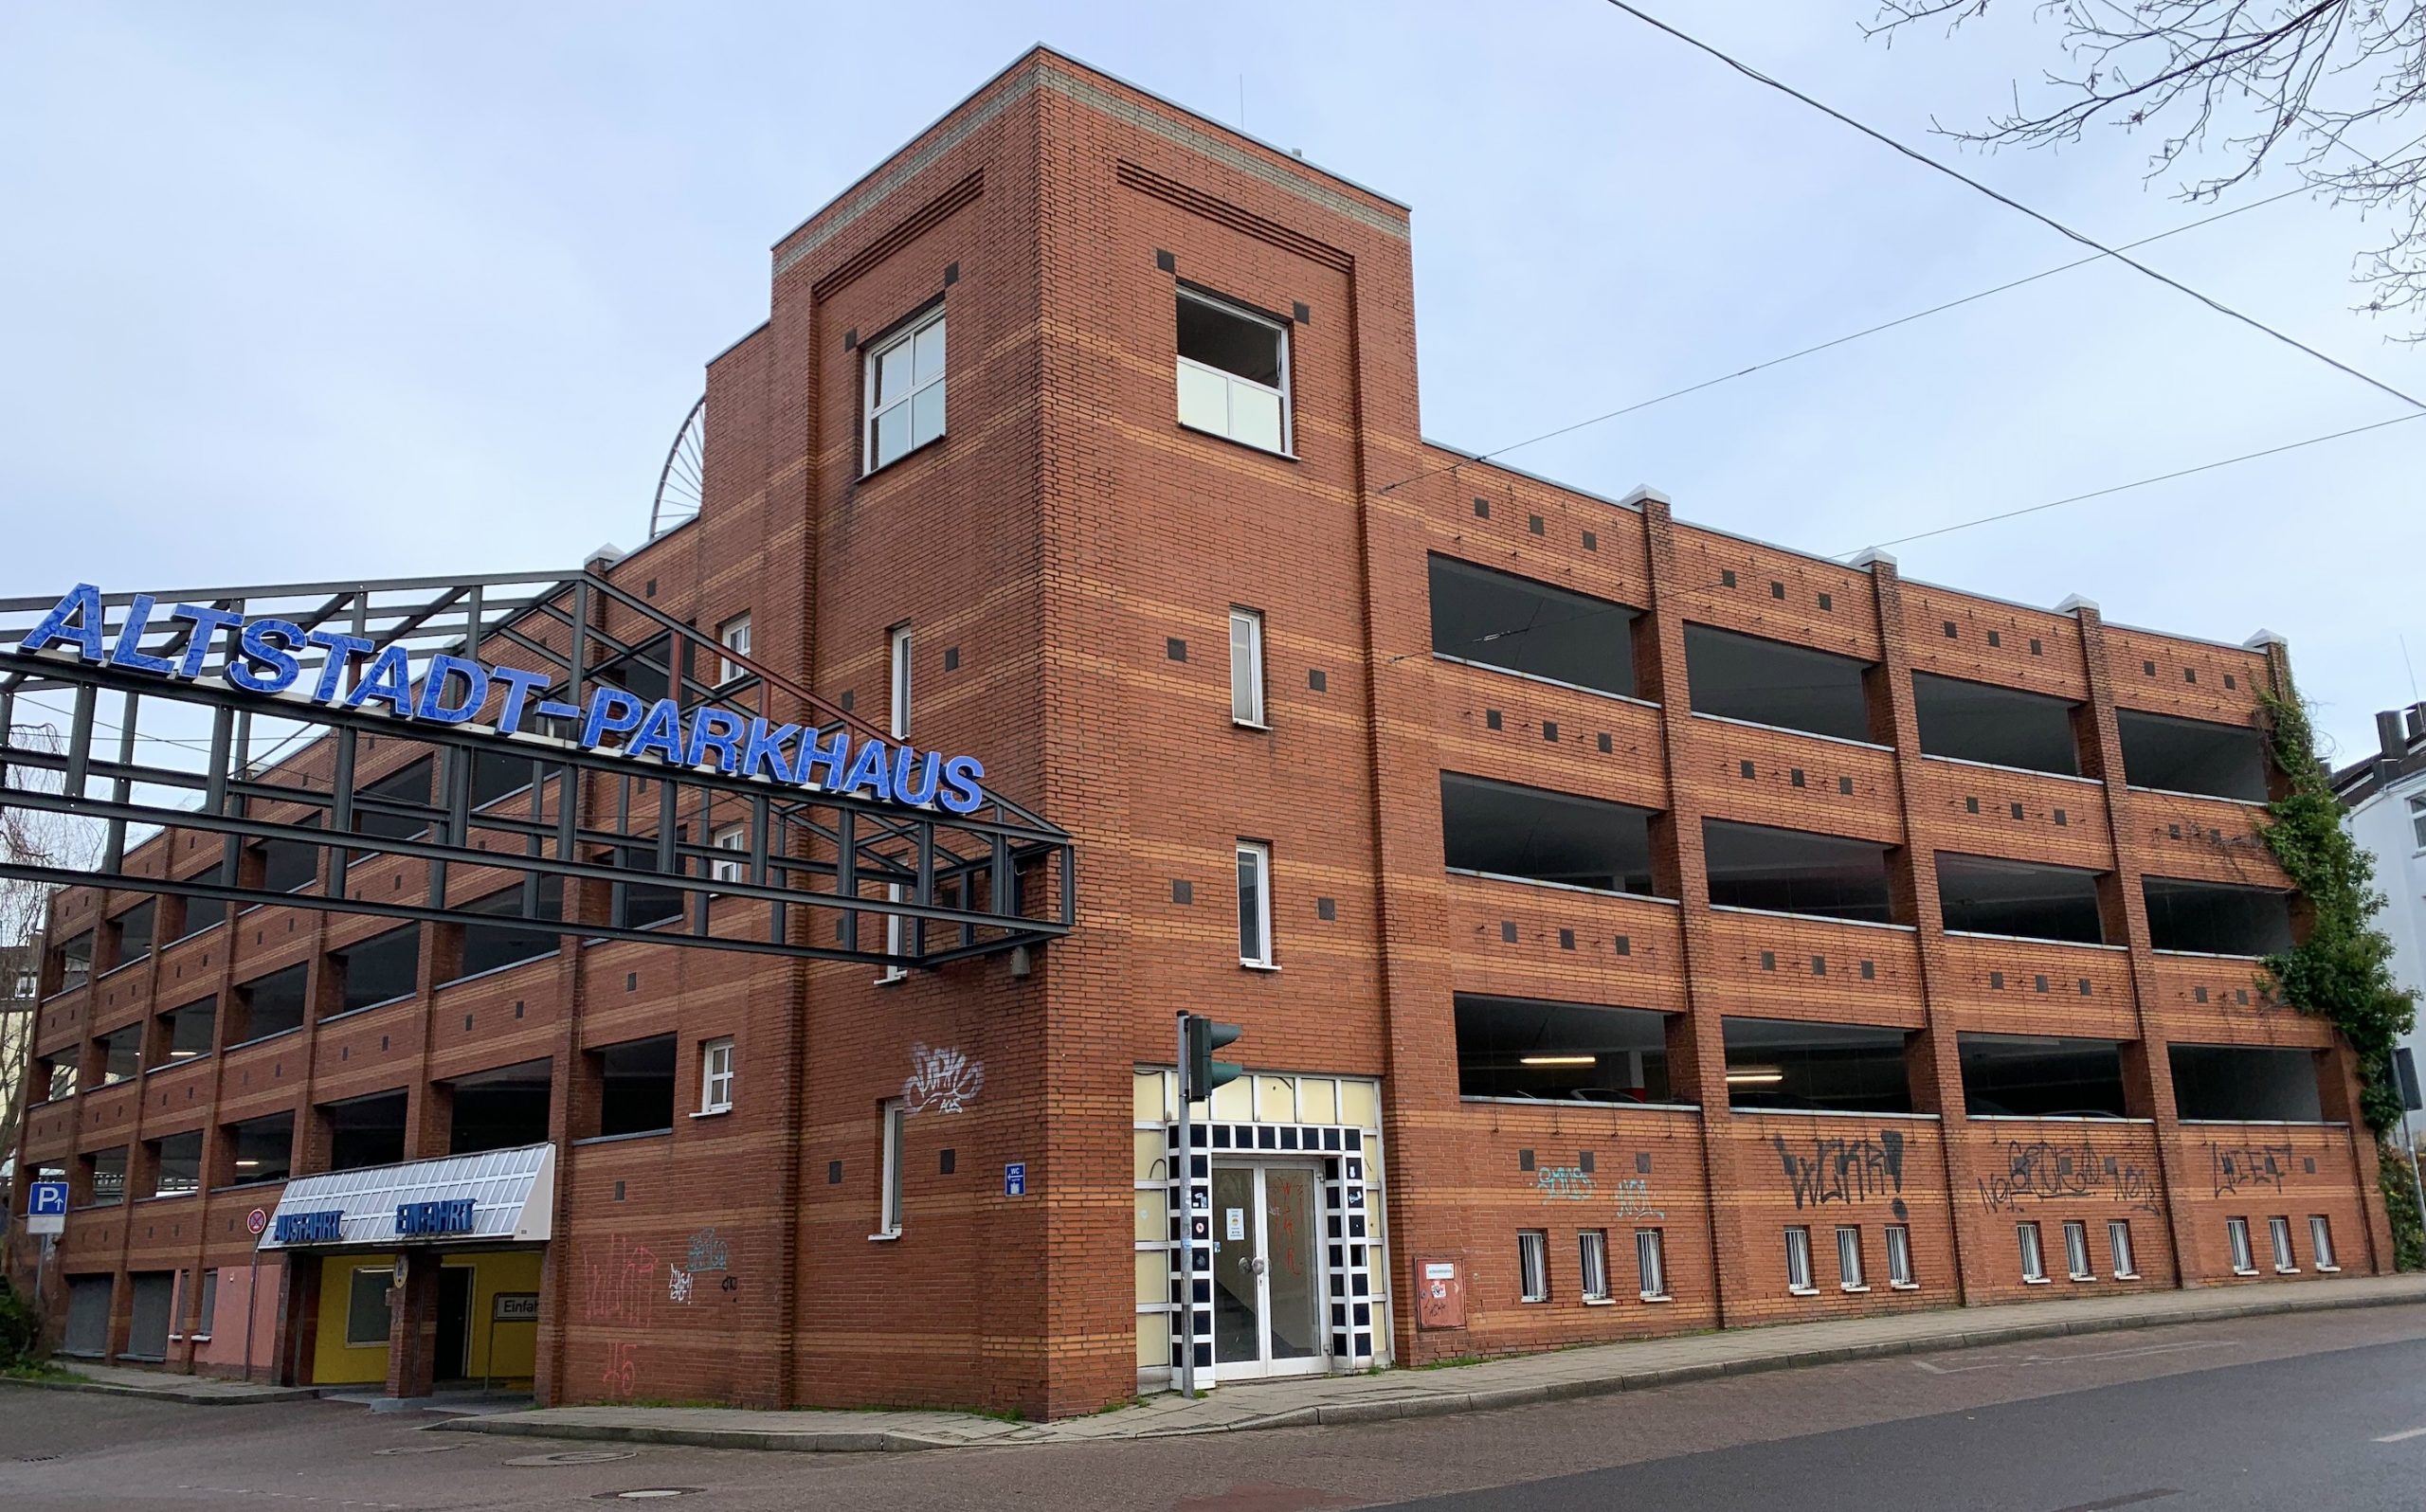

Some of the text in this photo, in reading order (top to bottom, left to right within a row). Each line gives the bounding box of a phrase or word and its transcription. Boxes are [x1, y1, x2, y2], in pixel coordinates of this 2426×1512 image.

[19, 582, 986, 814] ALTSTADT-PARKHAUS
[38, 1186, 60, 1212] P
[274, 1211, 345, 1241] AUSFAHRT
[395, 1198, 477, 1234] EINFAHRT
